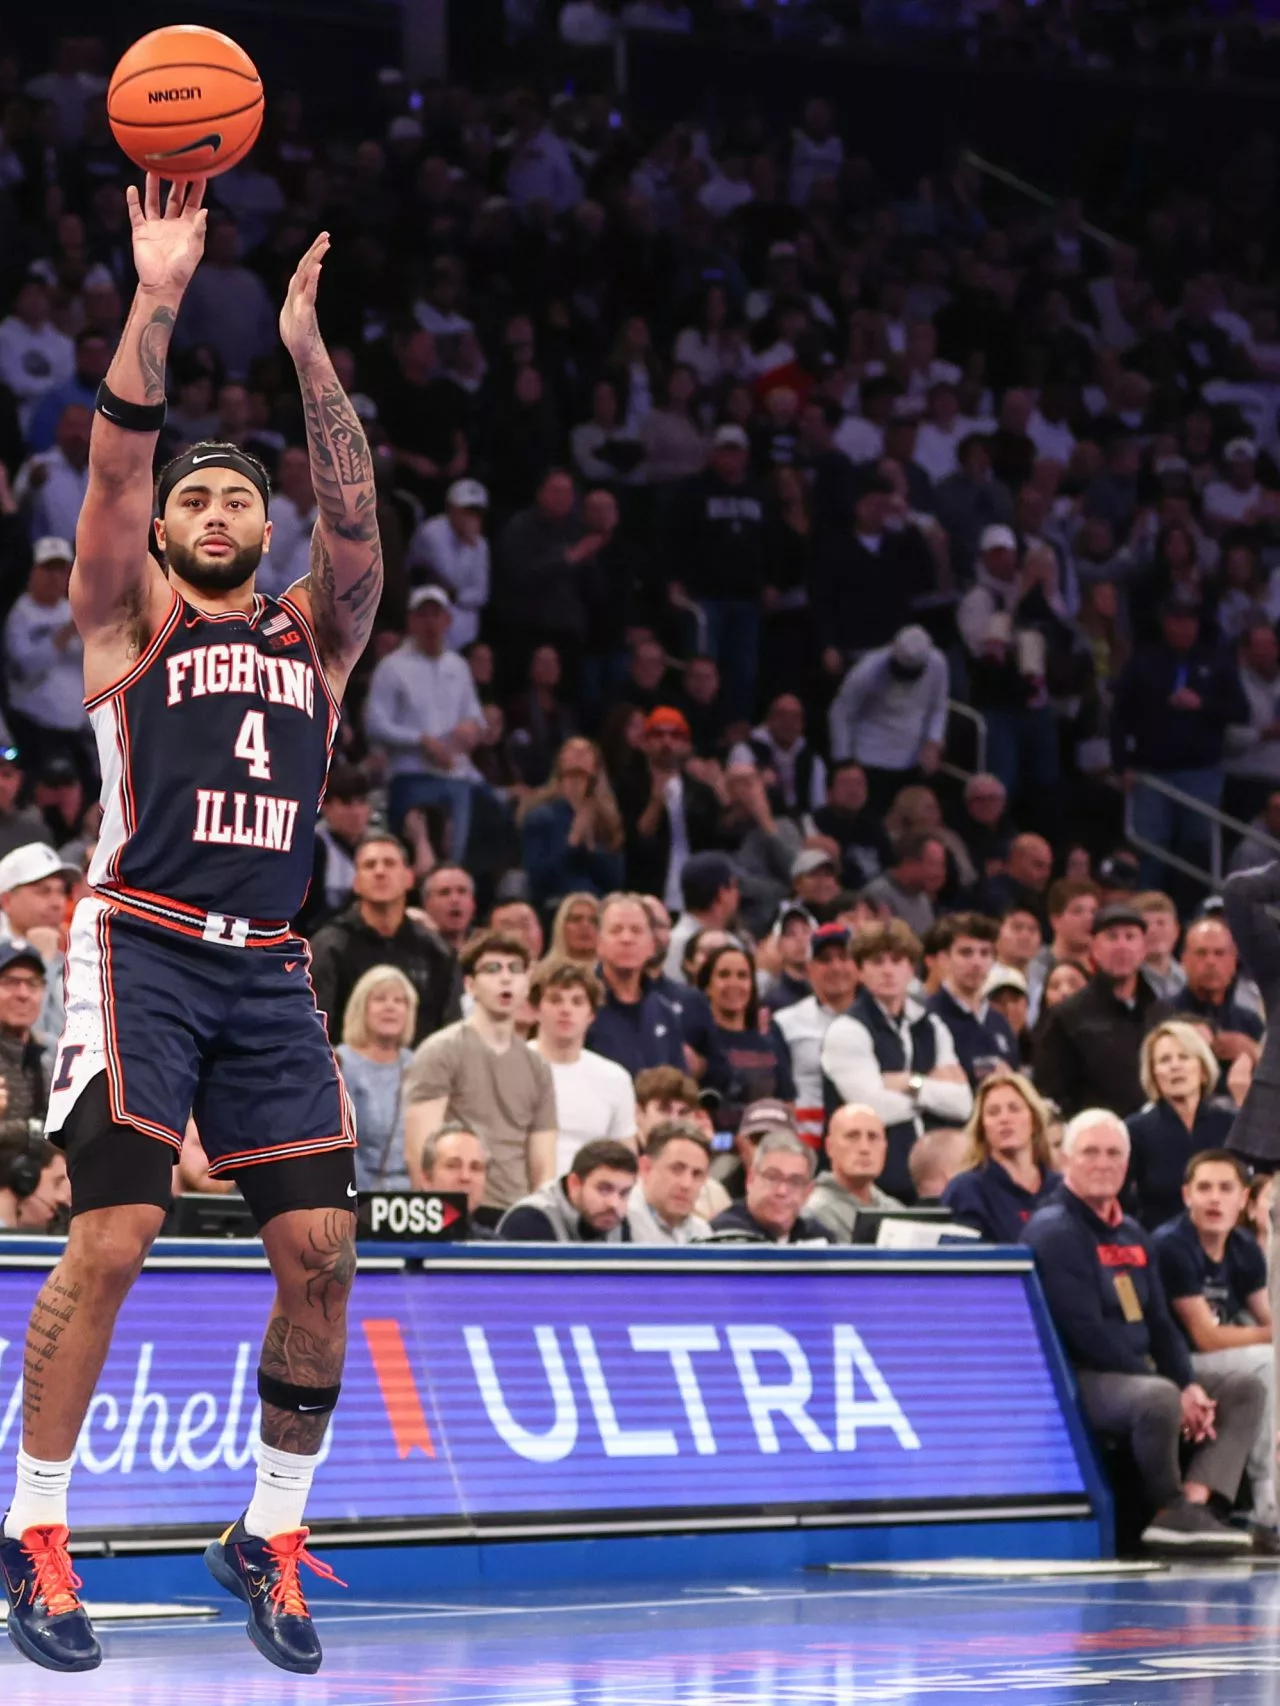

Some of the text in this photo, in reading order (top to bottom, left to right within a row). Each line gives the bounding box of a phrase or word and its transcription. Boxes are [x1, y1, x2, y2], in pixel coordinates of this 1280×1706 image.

[148, 87, 202, 104] UCONN
[166, 643, 314, 720] FIGHTING
[234, 709, 271, 780] 4
[192, 788, 300, 852] ILLINI
[53, 1044, 86, 1094] I
[371, 1196, 443, 1234] POSS
[463, 1325, 921, 1462] ULTRA
